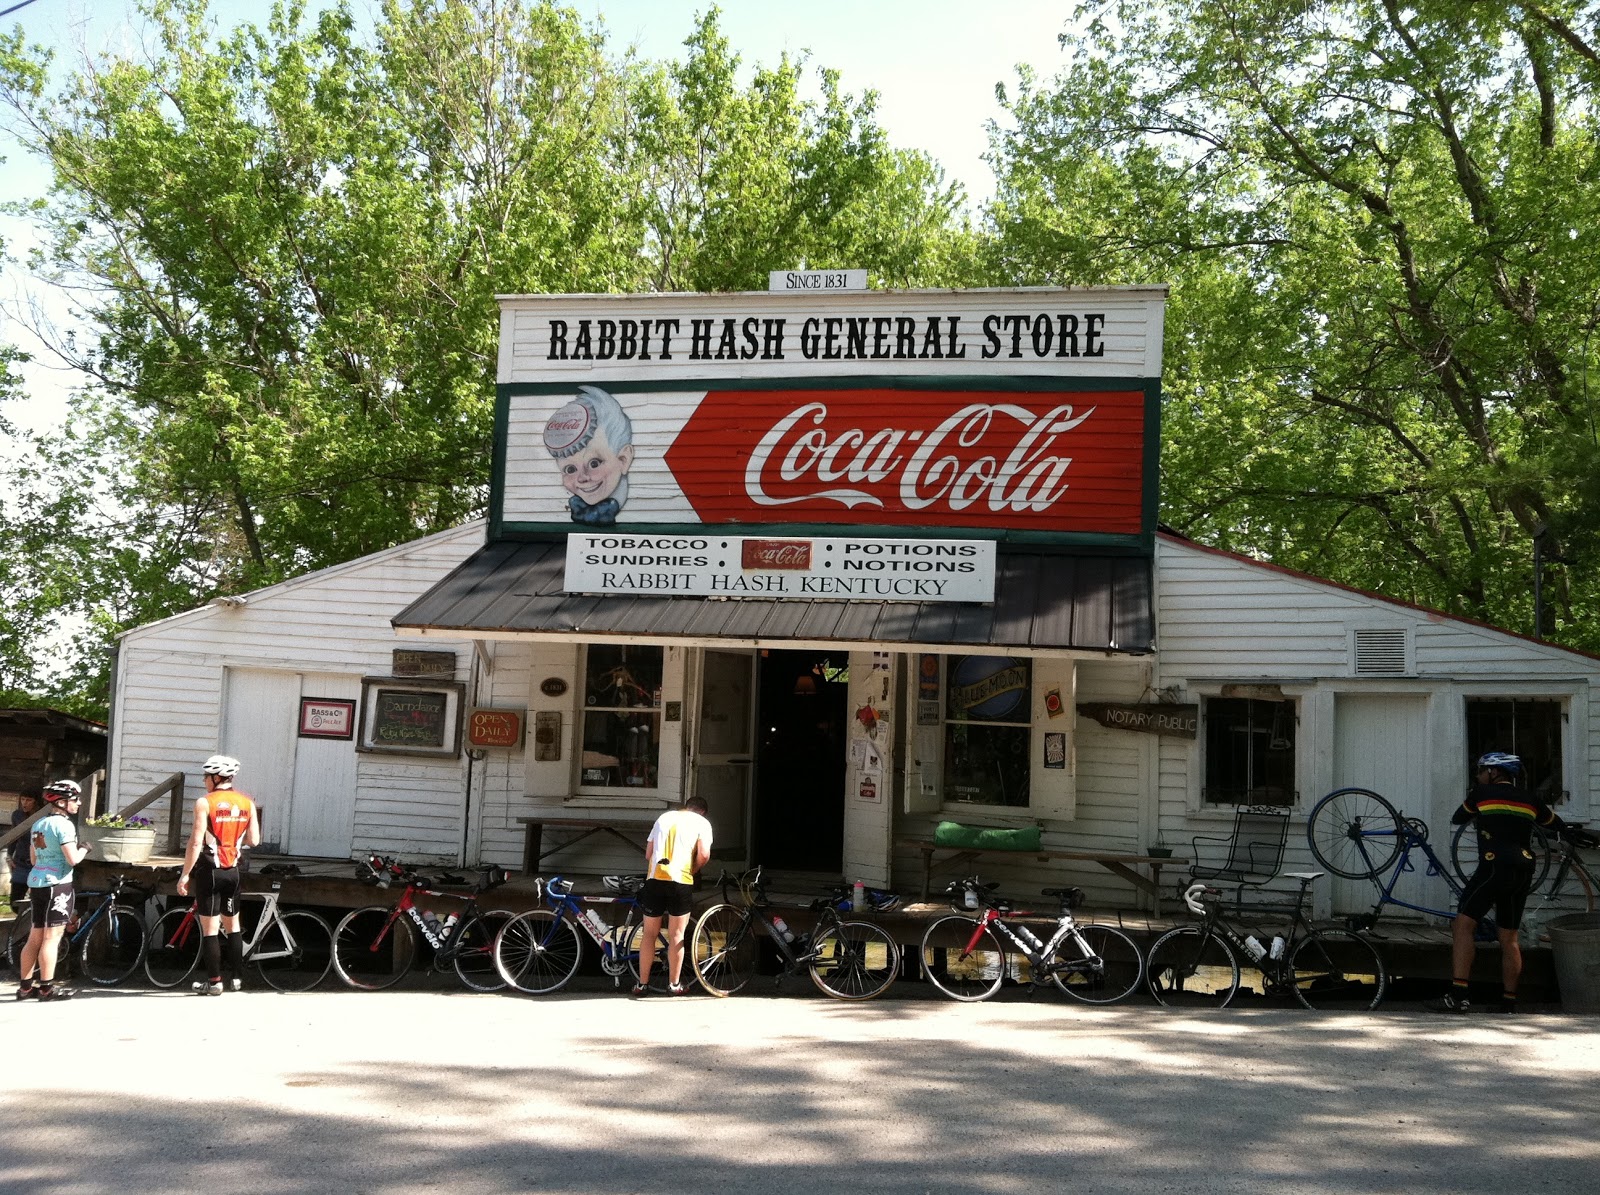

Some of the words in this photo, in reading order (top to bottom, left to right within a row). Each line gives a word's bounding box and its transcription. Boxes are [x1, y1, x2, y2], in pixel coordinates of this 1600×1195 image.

[786, 272, 821, 289] SINCE
[824, 273, 848, 289] 1831
[547, 319, 680, 360] RABBIT
[689, 317, 787, 360] HASH
[800, 316, 966, 360] GENERAL
[981, 313, 1105, 358] STORE
[745, 402, 1098, 512] Coca-Cola
[585, 538, 708, 549] TOBACCO
[845, 544, 977, 556] POTIONS
[585, 555, 708, 567] SUNDRIES
[752, 545, 809, 565] oca-Cola
[843, 560, 975, 573] NOTIONS
[602, 572, 697, 590] RABBIT
[800, 576, 949, 596] KENTUCKY
[474, 714, 508, 725] OPEN
[1106, 709, 1153, 726] NOTARY
[1158, 714, 1196, 731] PUBLIC
[474, 726, 511, 738] DAILY
[1226, 931, 1259, 963] RALEIGH
